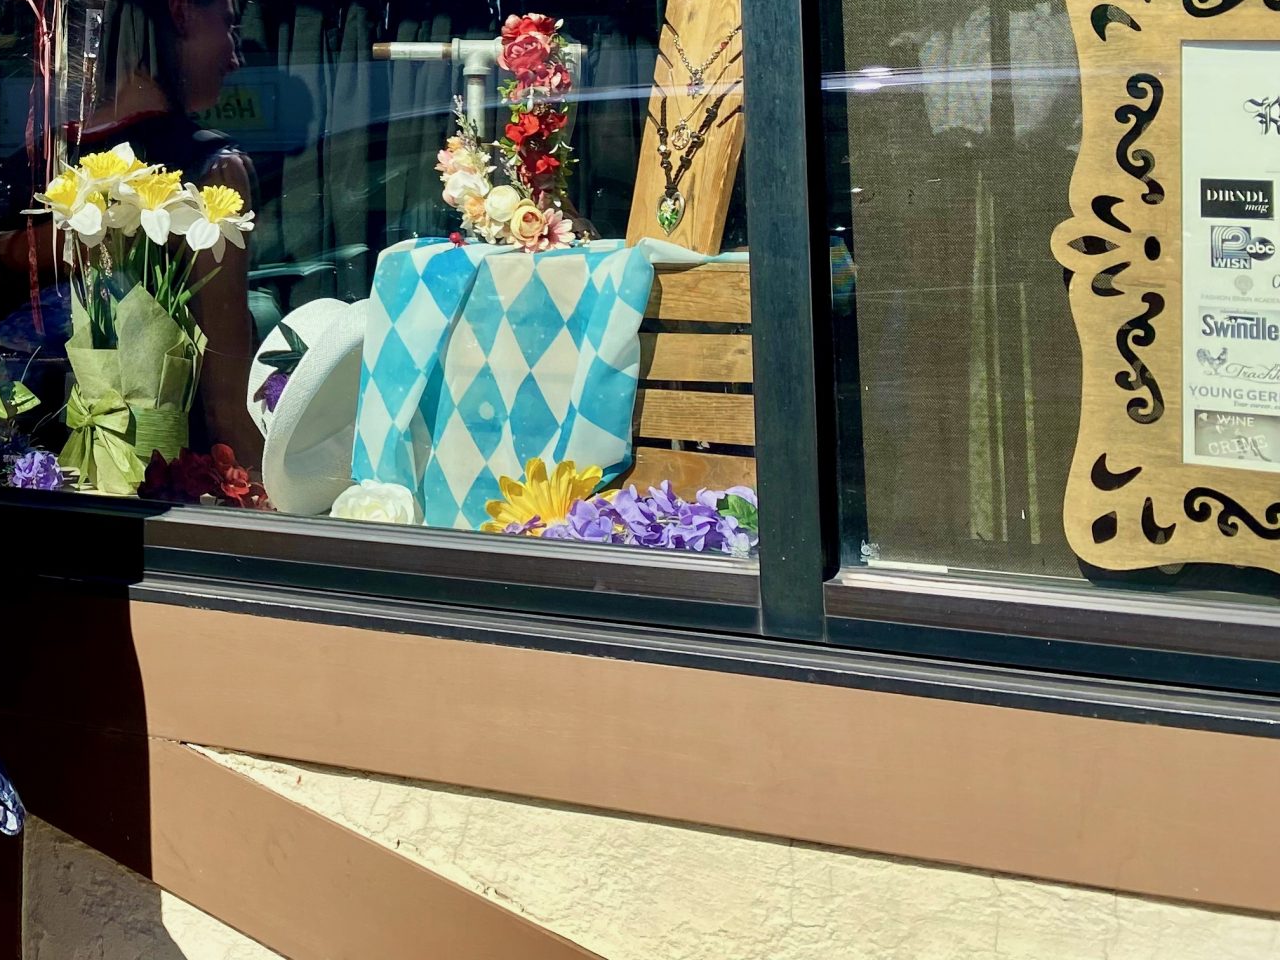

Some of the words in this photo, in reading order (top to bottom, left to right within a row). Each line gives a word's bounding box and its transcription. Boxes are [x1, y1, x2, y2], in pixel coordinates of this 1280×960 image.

[1206, 189, 1269, 203] DIRNDL
[1245, 204, 1269, 214] mag
[1246, 241, 1275, 254] abc
[1214, 258, 1250, 269] WISN
[1201, 313, 1280, 341] Swindle
[1189, 386, 1243, 400] YOUNG
[1247, 390, 1280, 402] GER
[1217, 414, 1255, 428] WINE
[1208, 434, 1268, 456] CRIME
